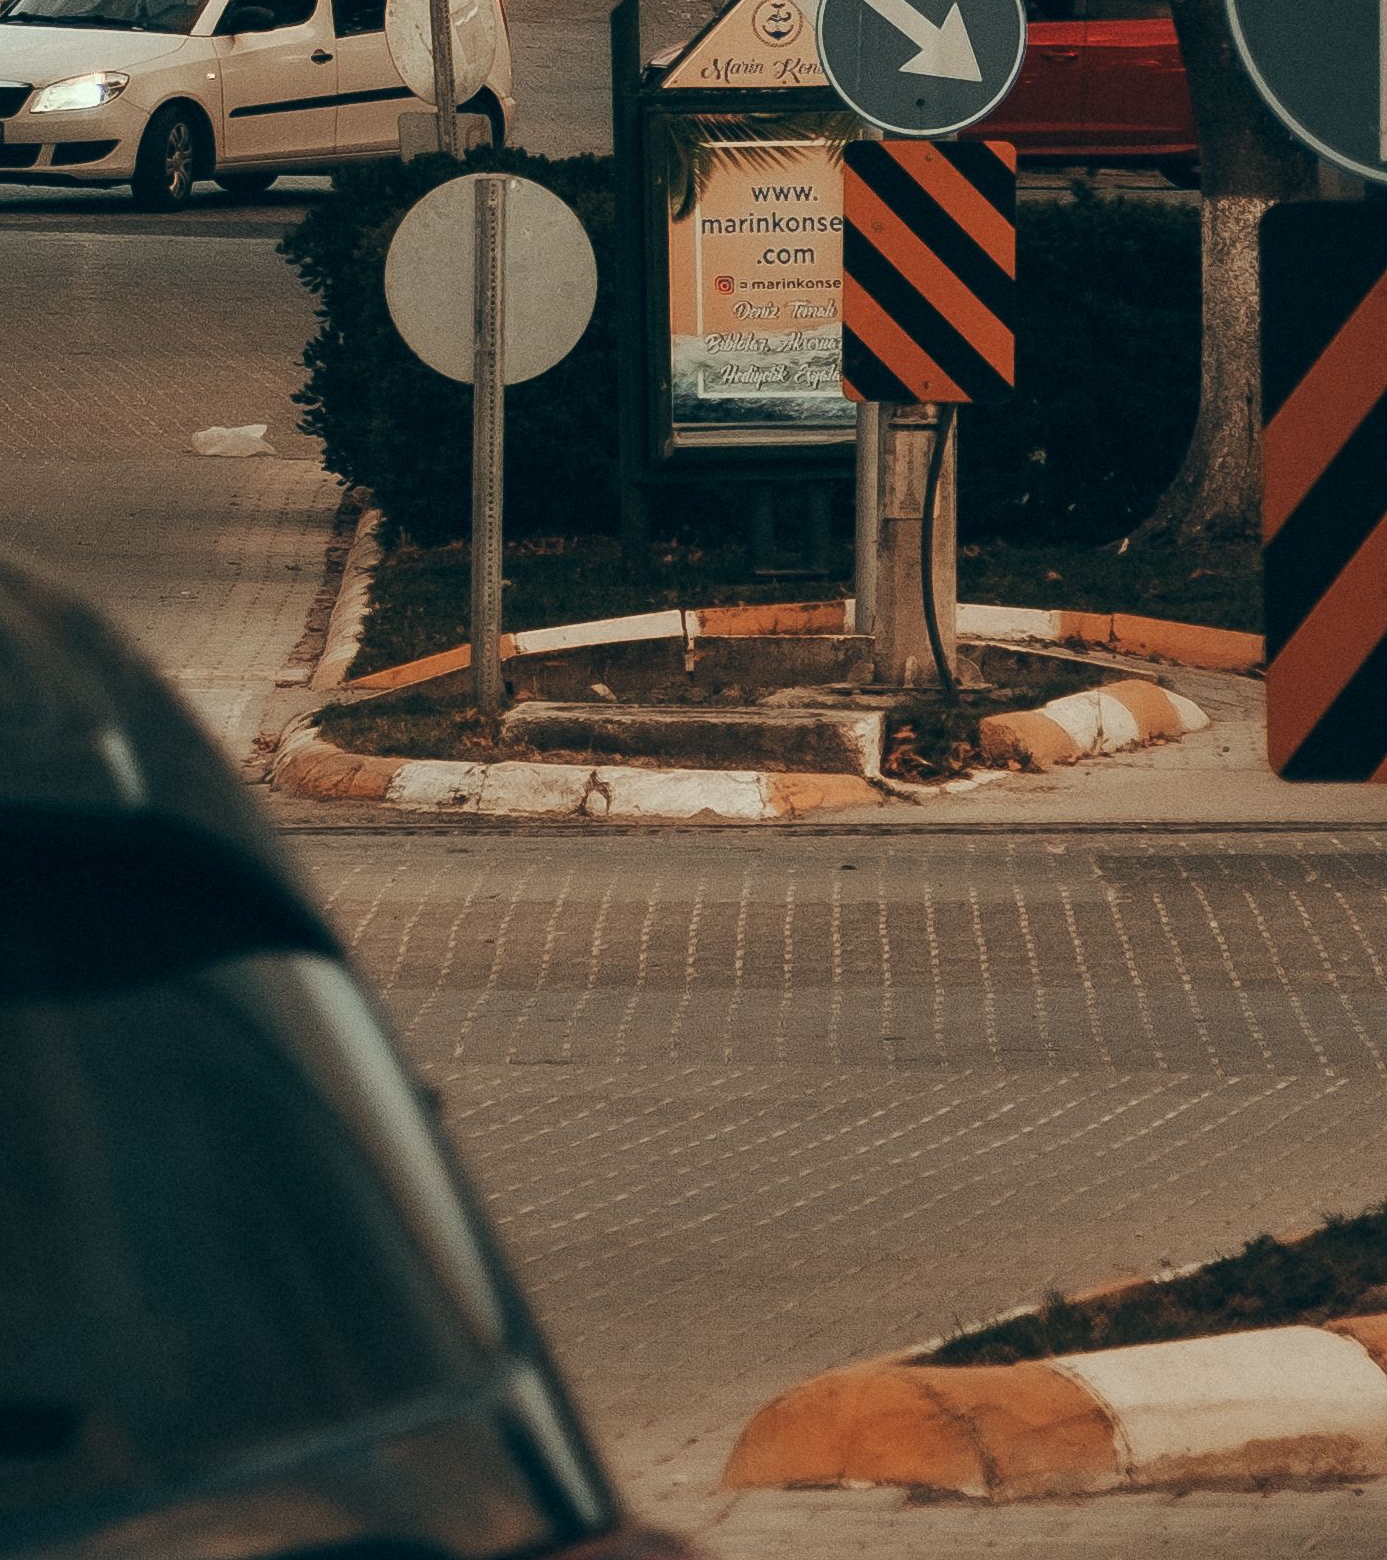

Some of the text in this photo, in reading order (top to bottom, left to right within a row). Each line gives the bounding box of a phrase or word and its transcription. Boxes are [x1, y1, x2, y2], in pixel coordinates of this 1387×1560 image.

[700, 58, 764, 84] Marin
[751, 186, 819, 202] www.
[701, 212, 844, 235] marinkonse
[756, 247, 815, 265] .com
[733, 300, 780, 320] Deniz
